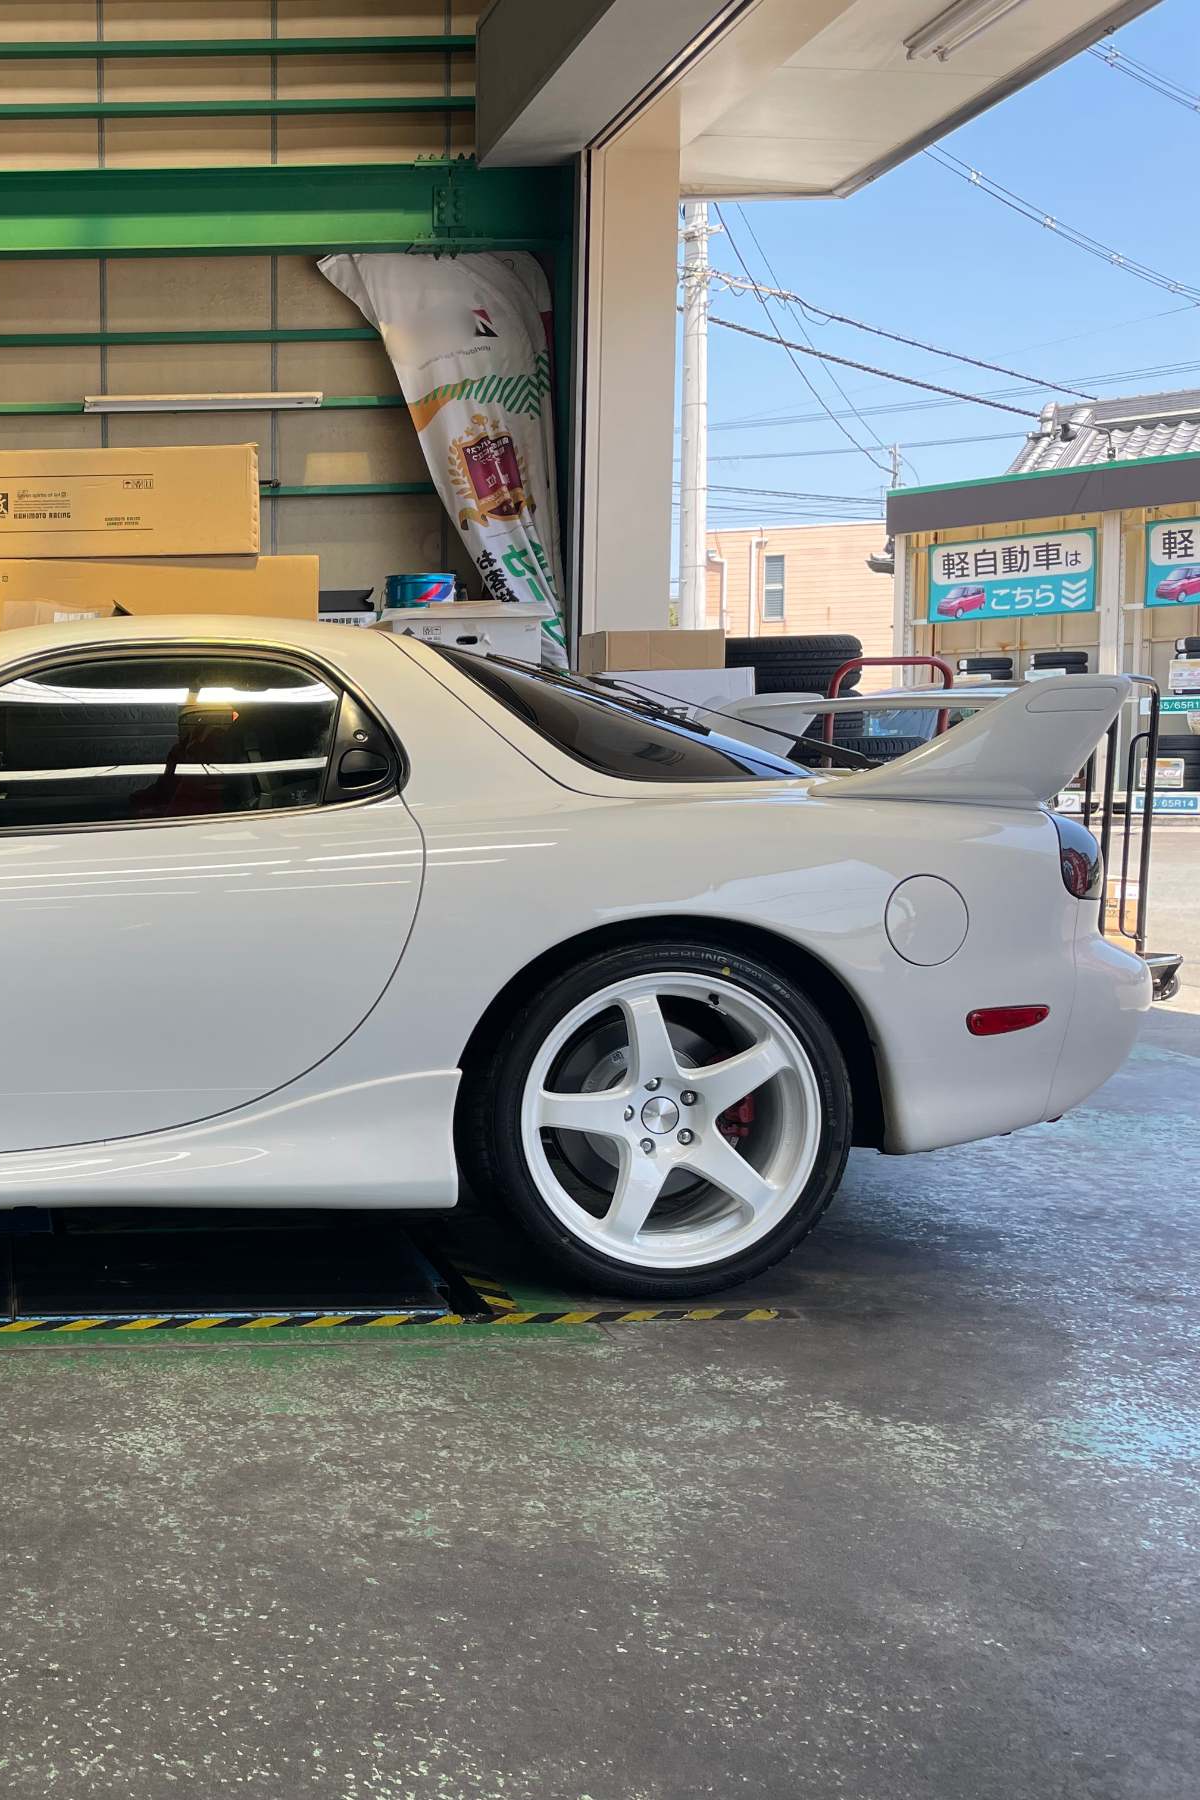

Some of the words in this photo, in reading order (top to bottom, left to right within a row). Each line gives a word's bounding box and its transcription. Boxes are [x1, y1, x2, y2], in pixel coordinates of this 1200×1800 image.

[13, 512, 47, 520] KAKIMOTO
[49, 511, 71, 519] RACING
[942, 542, 1082, 580] 軽自動車は
[990, 584, 1055, 610] こちら
[1159, 701, 1200, 710] 55/65R1
[1139, 799, 1194, 808] 15/65R14
